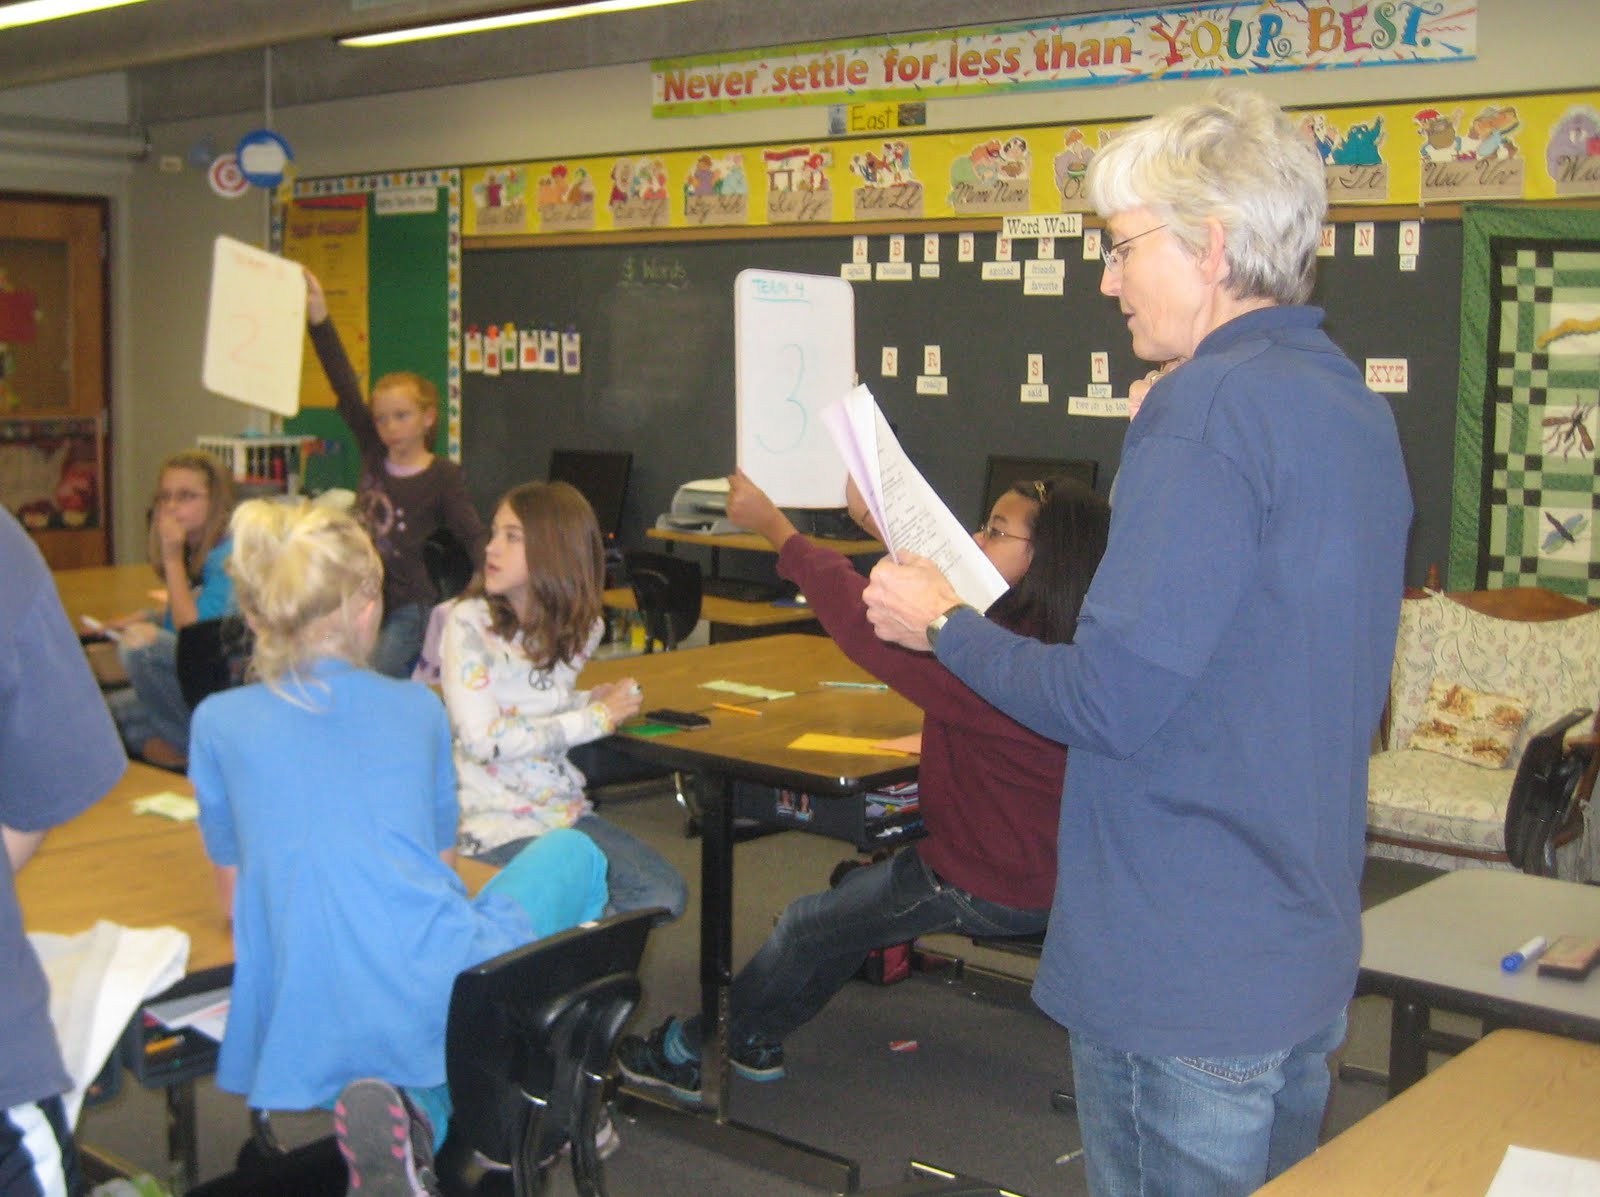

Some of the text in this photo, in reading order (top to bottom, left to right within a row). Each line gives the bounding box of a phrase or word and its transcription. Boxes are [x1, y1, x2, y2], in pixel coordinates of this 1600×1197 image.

[663, 69, 756, 101] Never
[771, 56, 868, 92] settle
[883, 48, 938, 83] for
[949, 45, 1020, 78] less
[1034, 35, 1132, 72] than
[1150, 12, 1293, 67] YOUR
[851, 104, 893, 131] East
[1007, 216, 1076, 236] Word Wall
[999, 238, 1008, 253] E
[1041, 237, 1050, 253] F
[1087, 235, 1096, 252] G
[1320, 229, 1333, 247] M
[1358, 228, 1371, 247] N
[1404, 228, 1414, 246] O
[855, 240, 865, 257] A
[892, 240, 902, 256] B
[926, 239, 935, 255] C
[962, 239, 971, 255] D
[228, 313, 274, 372] 2
[885, 351, 895, 371] Q
[927, 352, 938, 368] R
[1094, 357, 1104, 374] T
[1031, 361, 1040, 377] S
[1368, 364, 1404, 383] XYZ
[756, 343, 808, 455] 3
